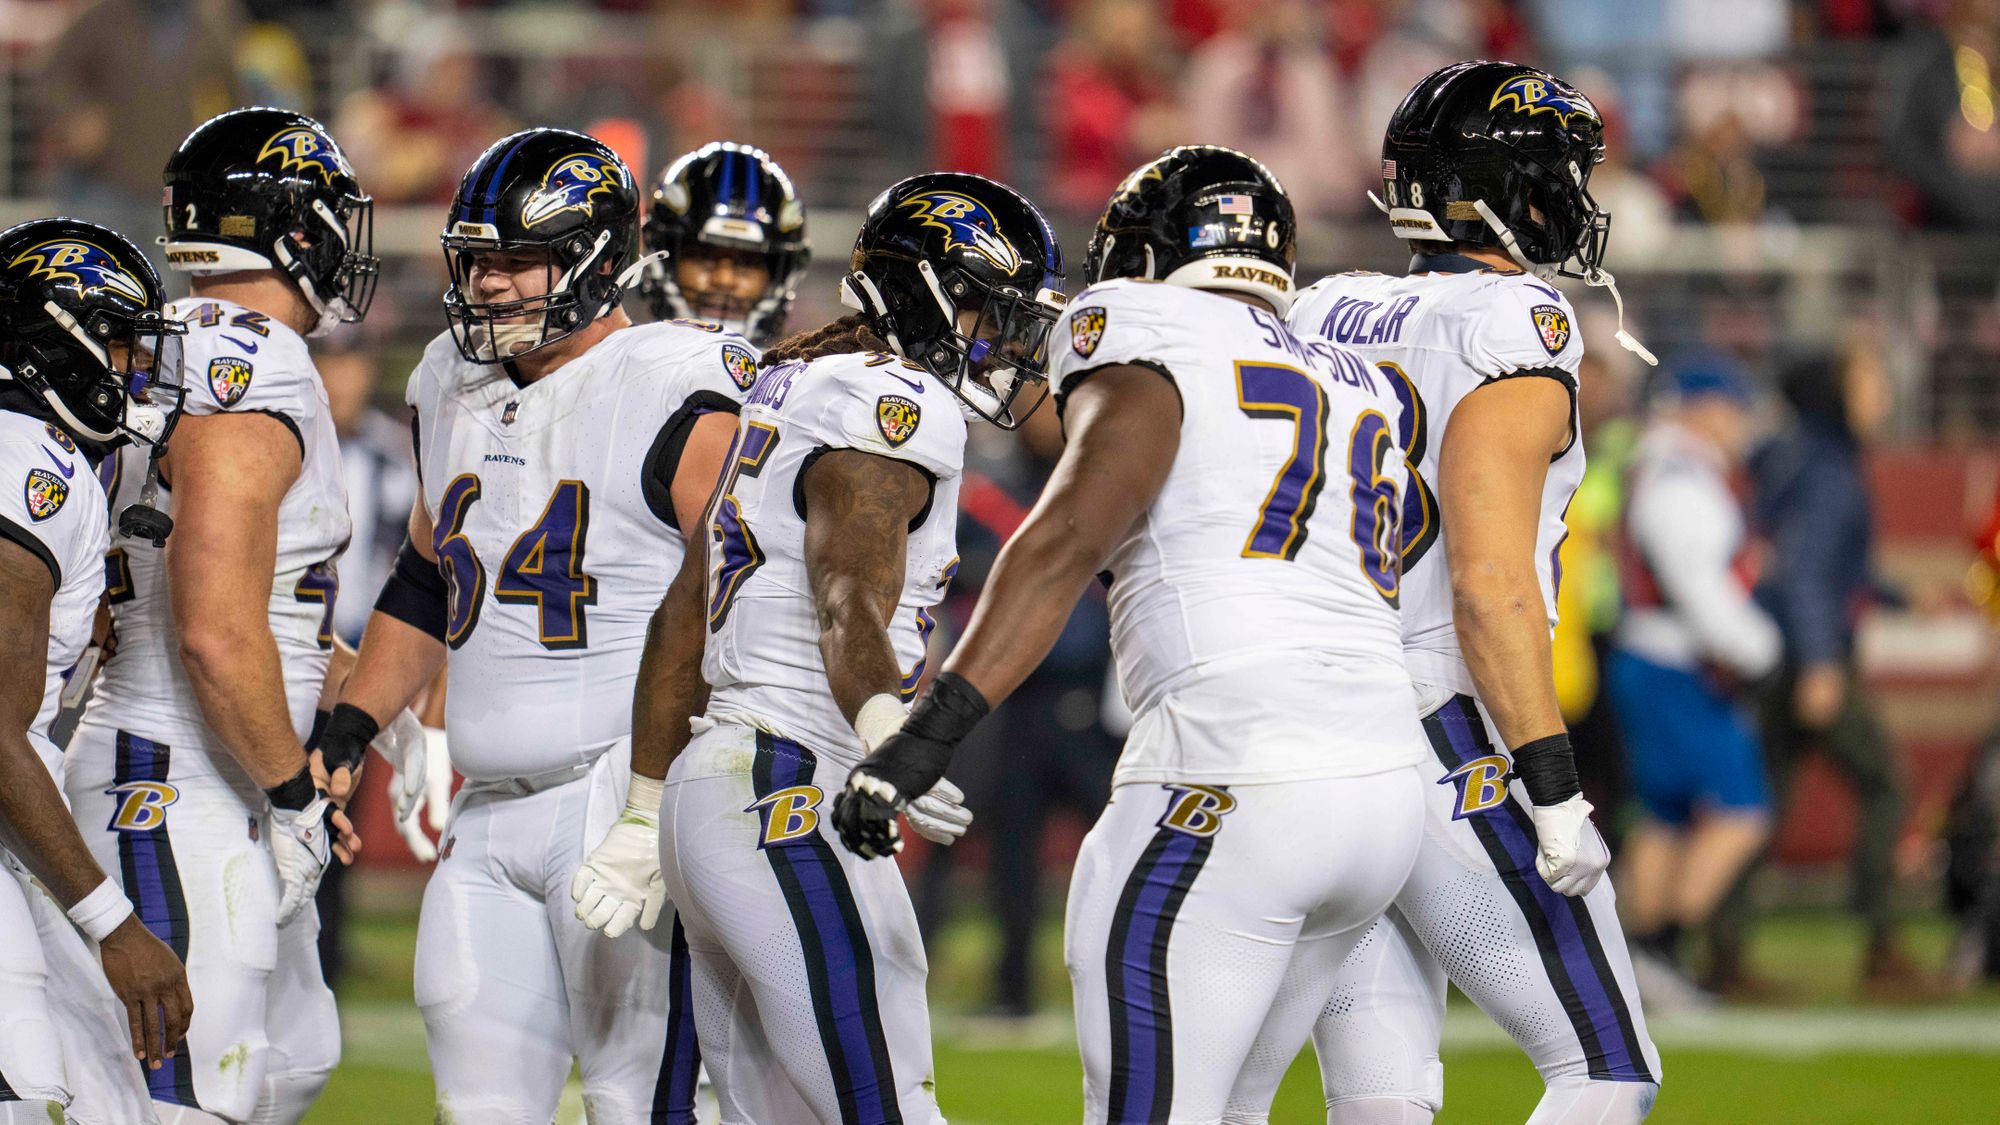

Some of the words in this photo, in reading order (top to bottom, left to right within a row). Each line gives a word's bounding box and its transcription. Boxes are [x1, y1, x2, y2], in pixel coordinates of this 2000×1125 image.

[1509, 78, 1548, 103] B
[279, 131, 318, 157] B
[554, 160, 602, 182] B
[932, 195, 975, 219] B
[41, 243, 90, 267] B
[1213, 265, 1289, 292] RAVENS
[1319, 295, 1419, 345] KOLAR
[881, 397, 918, 411] RAVENS
[484, 454, 526, 466] RAVENS
[32, 470, 67, 492] RAVENS
[1233, 360, 1400, 610] 76
[432, 473, 598, 650] 64
[1437, 754, 1511, 821] B
[104, 780, 180, 832] B
[743, 785, 824, 850] B
